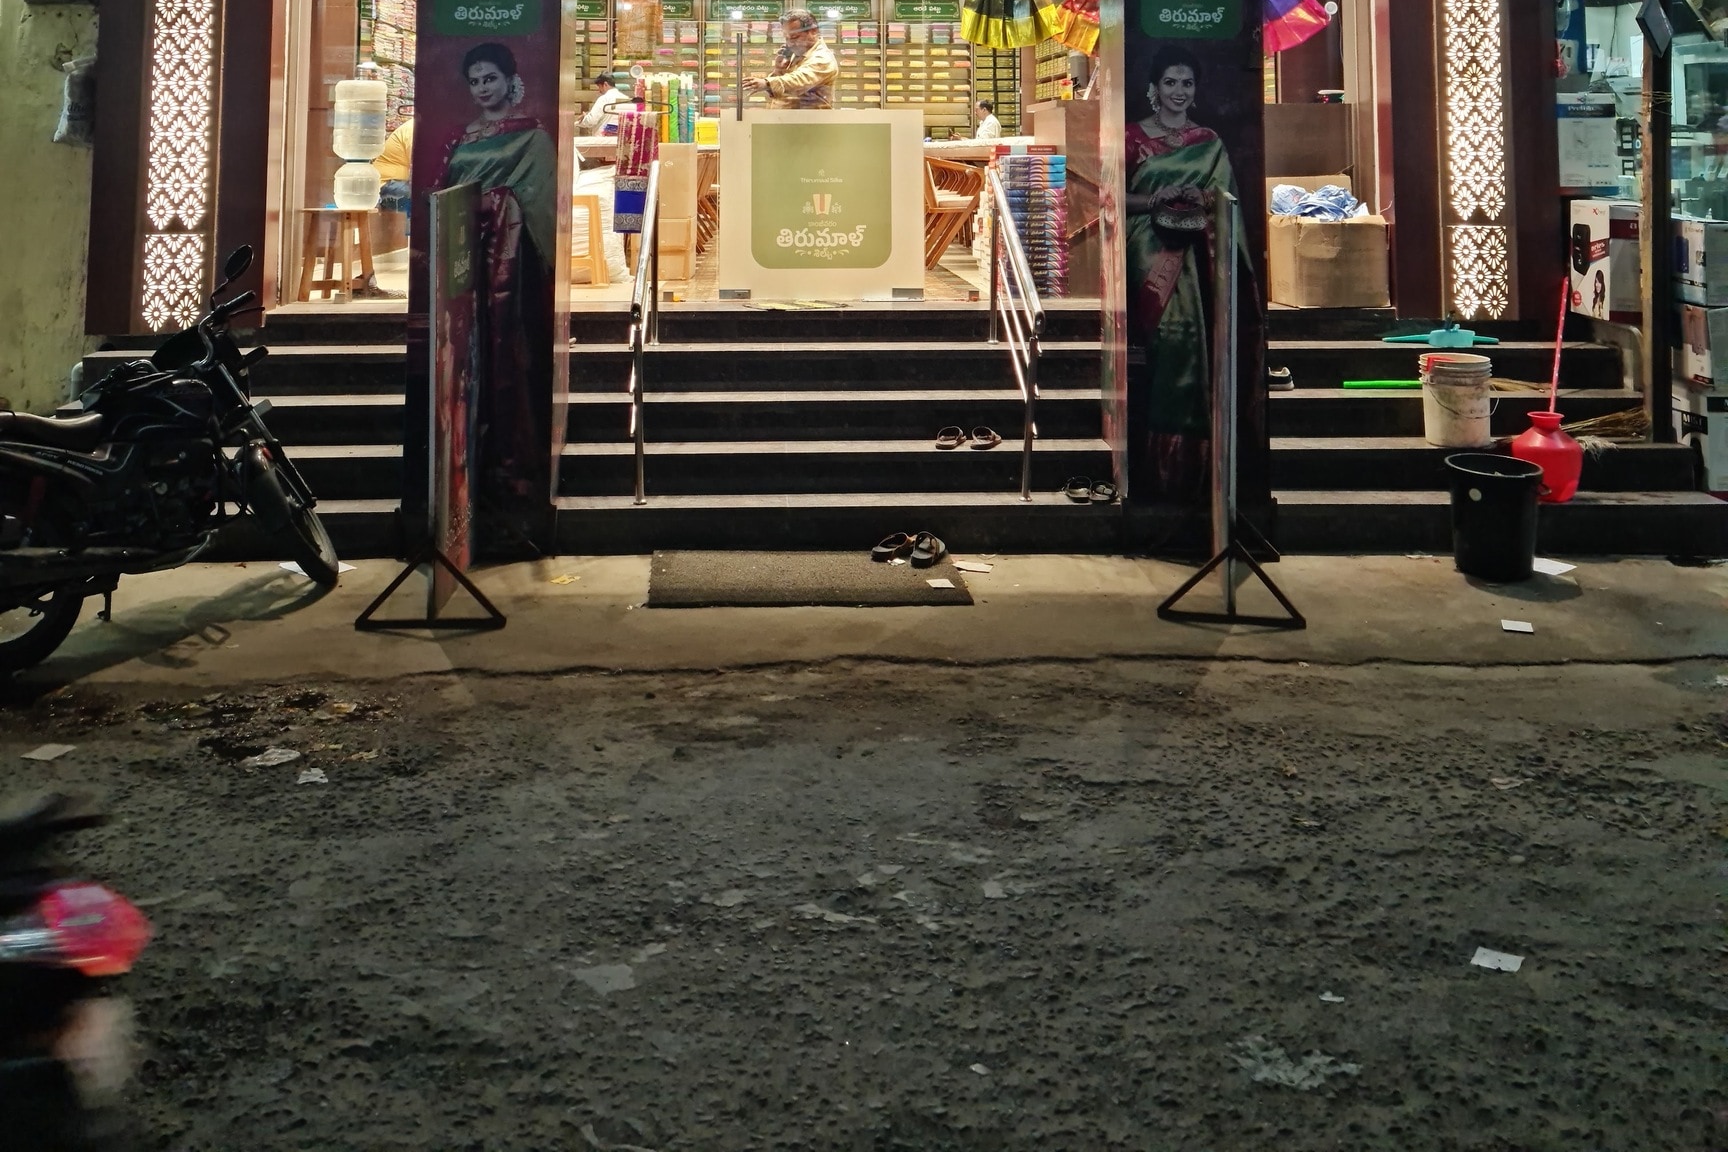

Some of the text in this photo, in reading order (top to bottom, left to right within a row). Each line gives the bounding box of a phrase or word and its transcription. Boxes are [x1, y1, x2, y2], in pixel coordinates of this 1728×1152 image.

[454, 4, 525, 20] తిరుమాళ్
[1159, 7, 1226, 24] తిరుమాళ్
[776, 224, 867, 248] తిరుమాళ్
